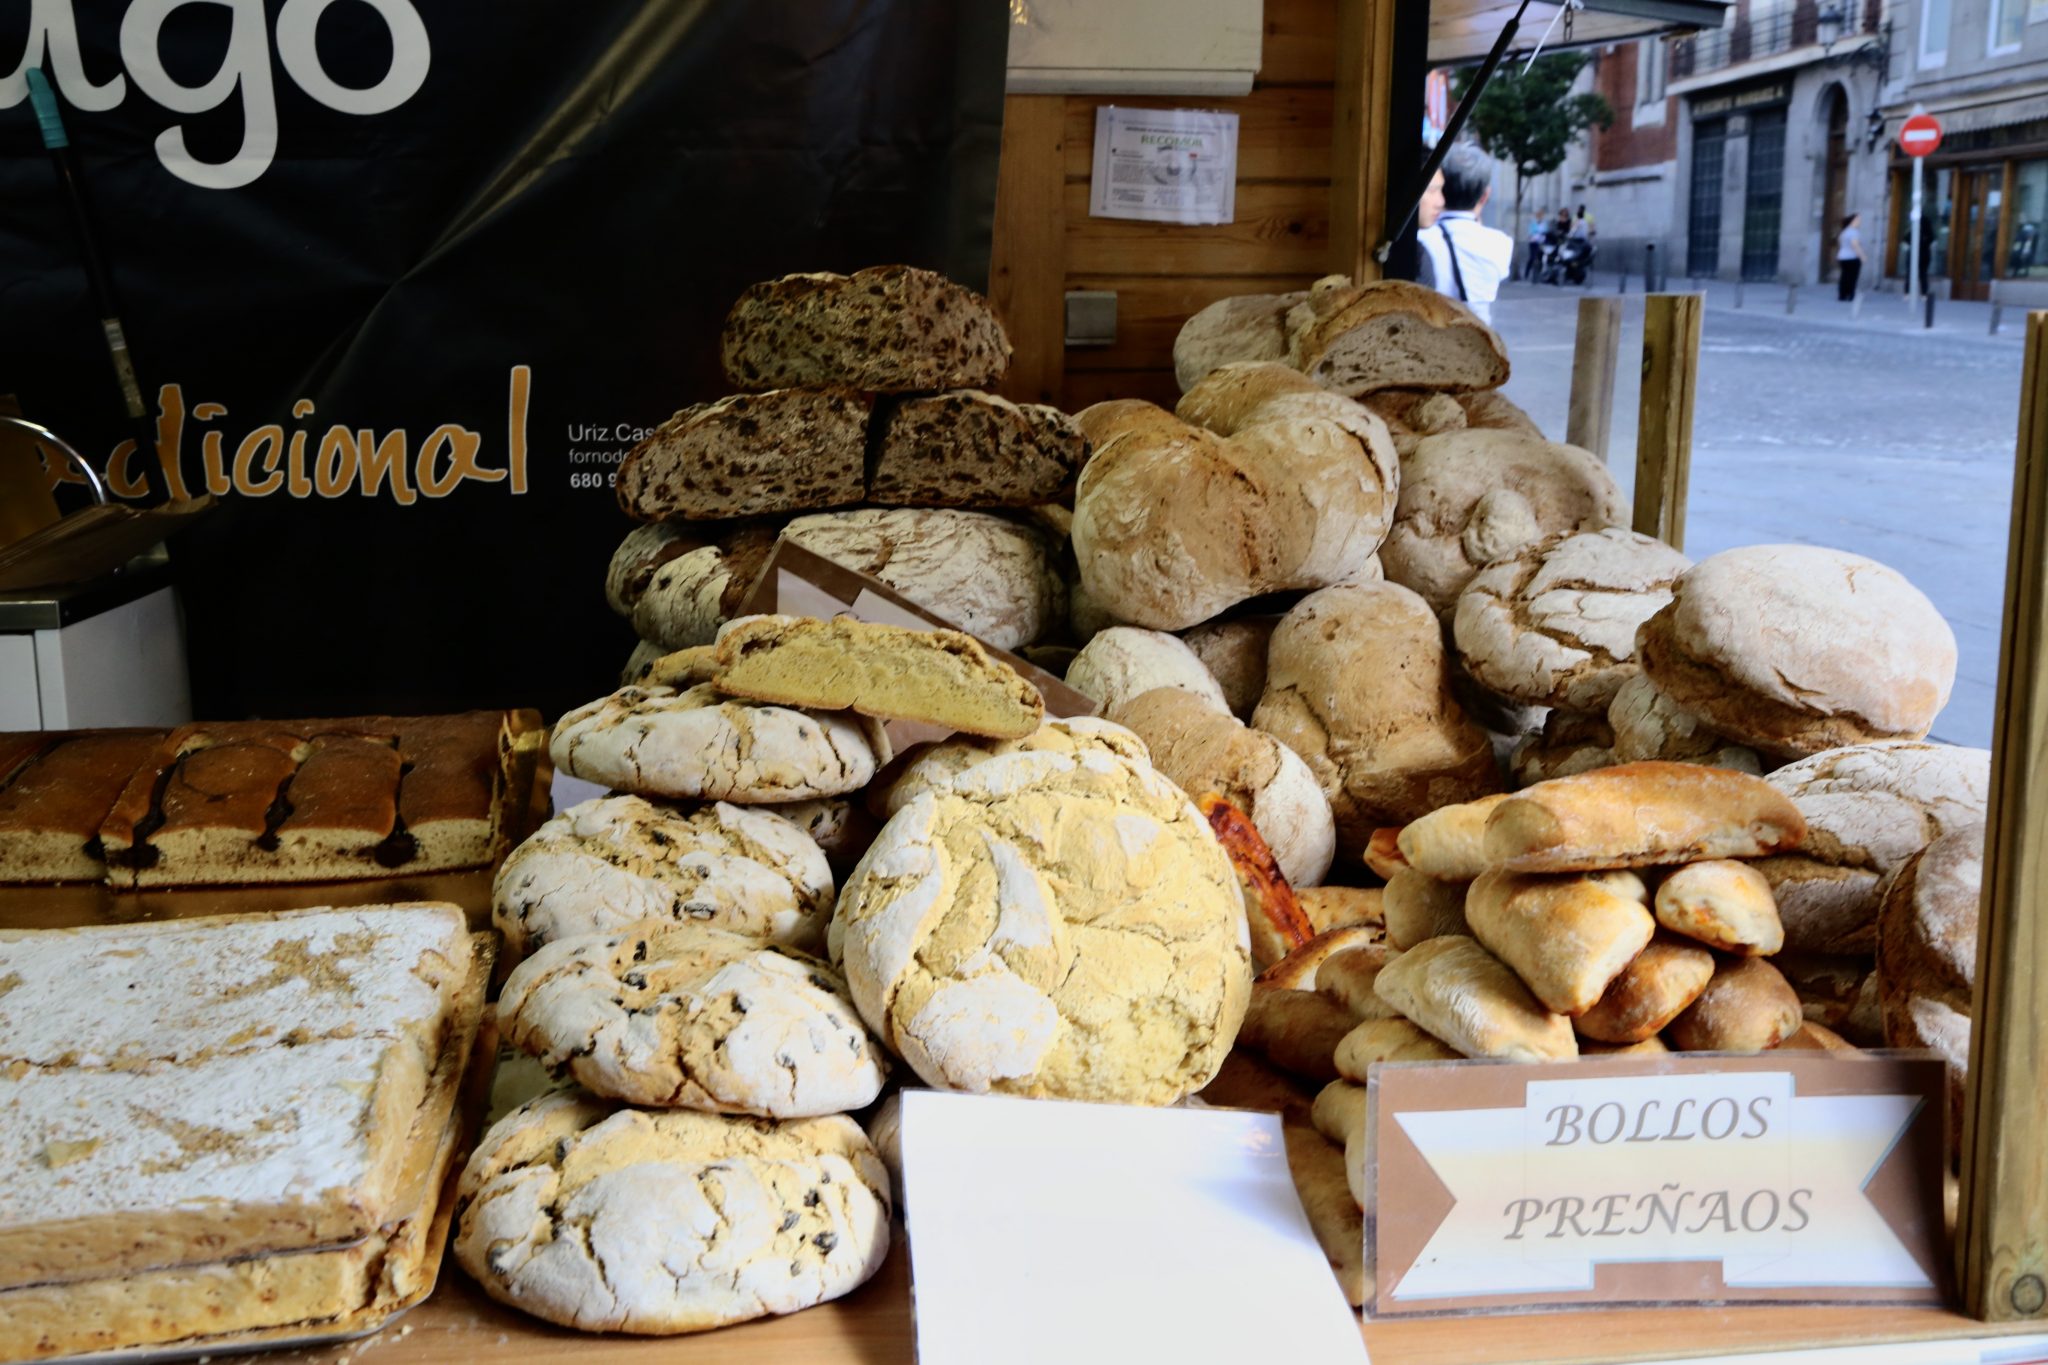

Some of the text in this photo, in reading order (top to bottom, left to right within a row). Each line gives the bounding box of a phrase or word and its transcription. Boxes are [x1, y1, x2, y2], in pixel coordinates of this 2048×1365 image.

[570, 472, 603, 488] 680
[1545, 1096, 1772, 1146] BOLLOS
[1503, 1182, 1813, 1240] PREÑAOS
